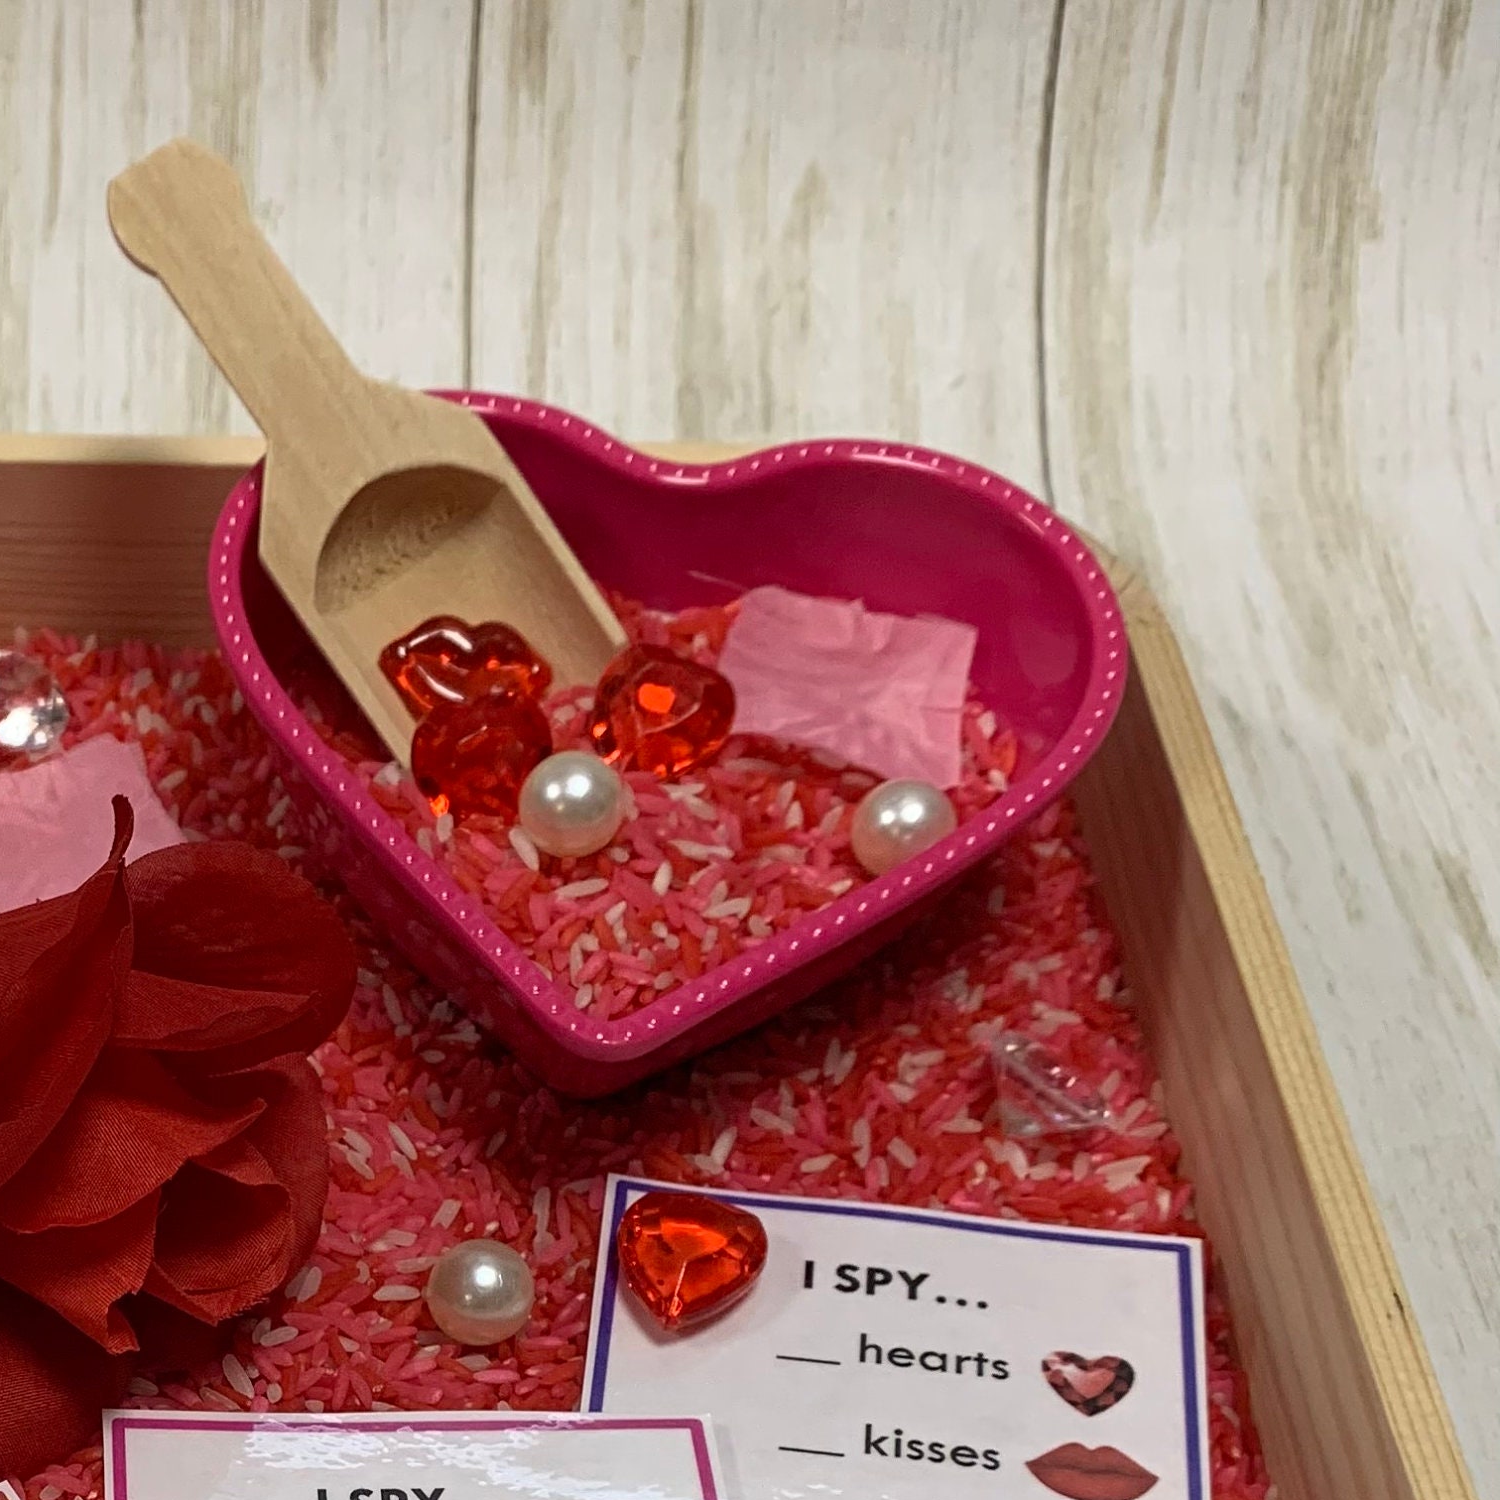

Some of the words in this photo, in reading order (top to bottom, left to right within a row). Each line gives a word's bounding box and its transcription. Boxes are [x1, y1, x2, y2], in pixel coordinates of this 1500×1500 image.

[803, 1260, 815, 1289] I
[859, 1333, 1009, 1380] hearts
[864, 1423, 1000, 1471] kisses
